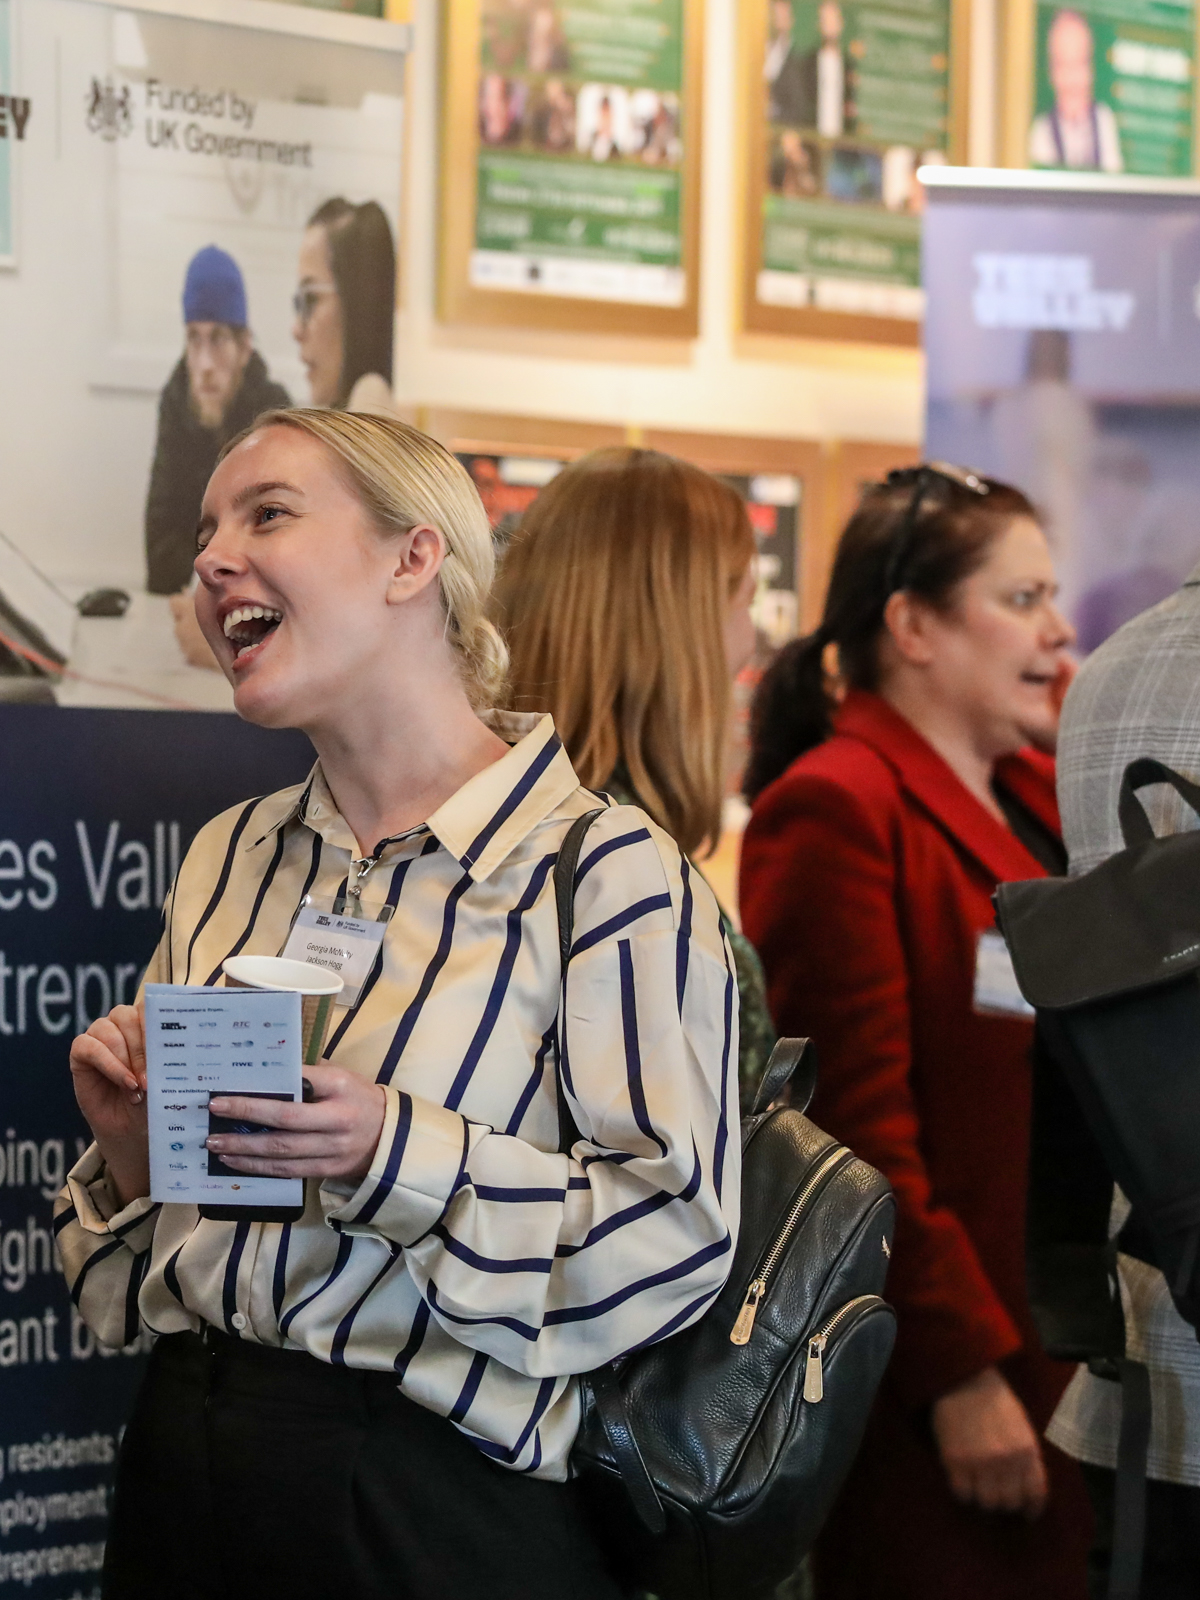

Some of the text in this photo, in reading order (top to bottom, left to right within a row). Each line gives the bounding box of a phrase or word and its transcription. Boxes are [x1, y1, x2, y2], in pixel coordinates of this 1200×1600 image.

[145, 79, 258, 130] Funded by
[145, 118, 313, 169] UK Government
[75, 819, 180, 910] Vall
[306, 955, 344, 971] Jackson Hogg
[307, 942, 328, 954] Georgia
[8, 1432, 115, 1472] residents
